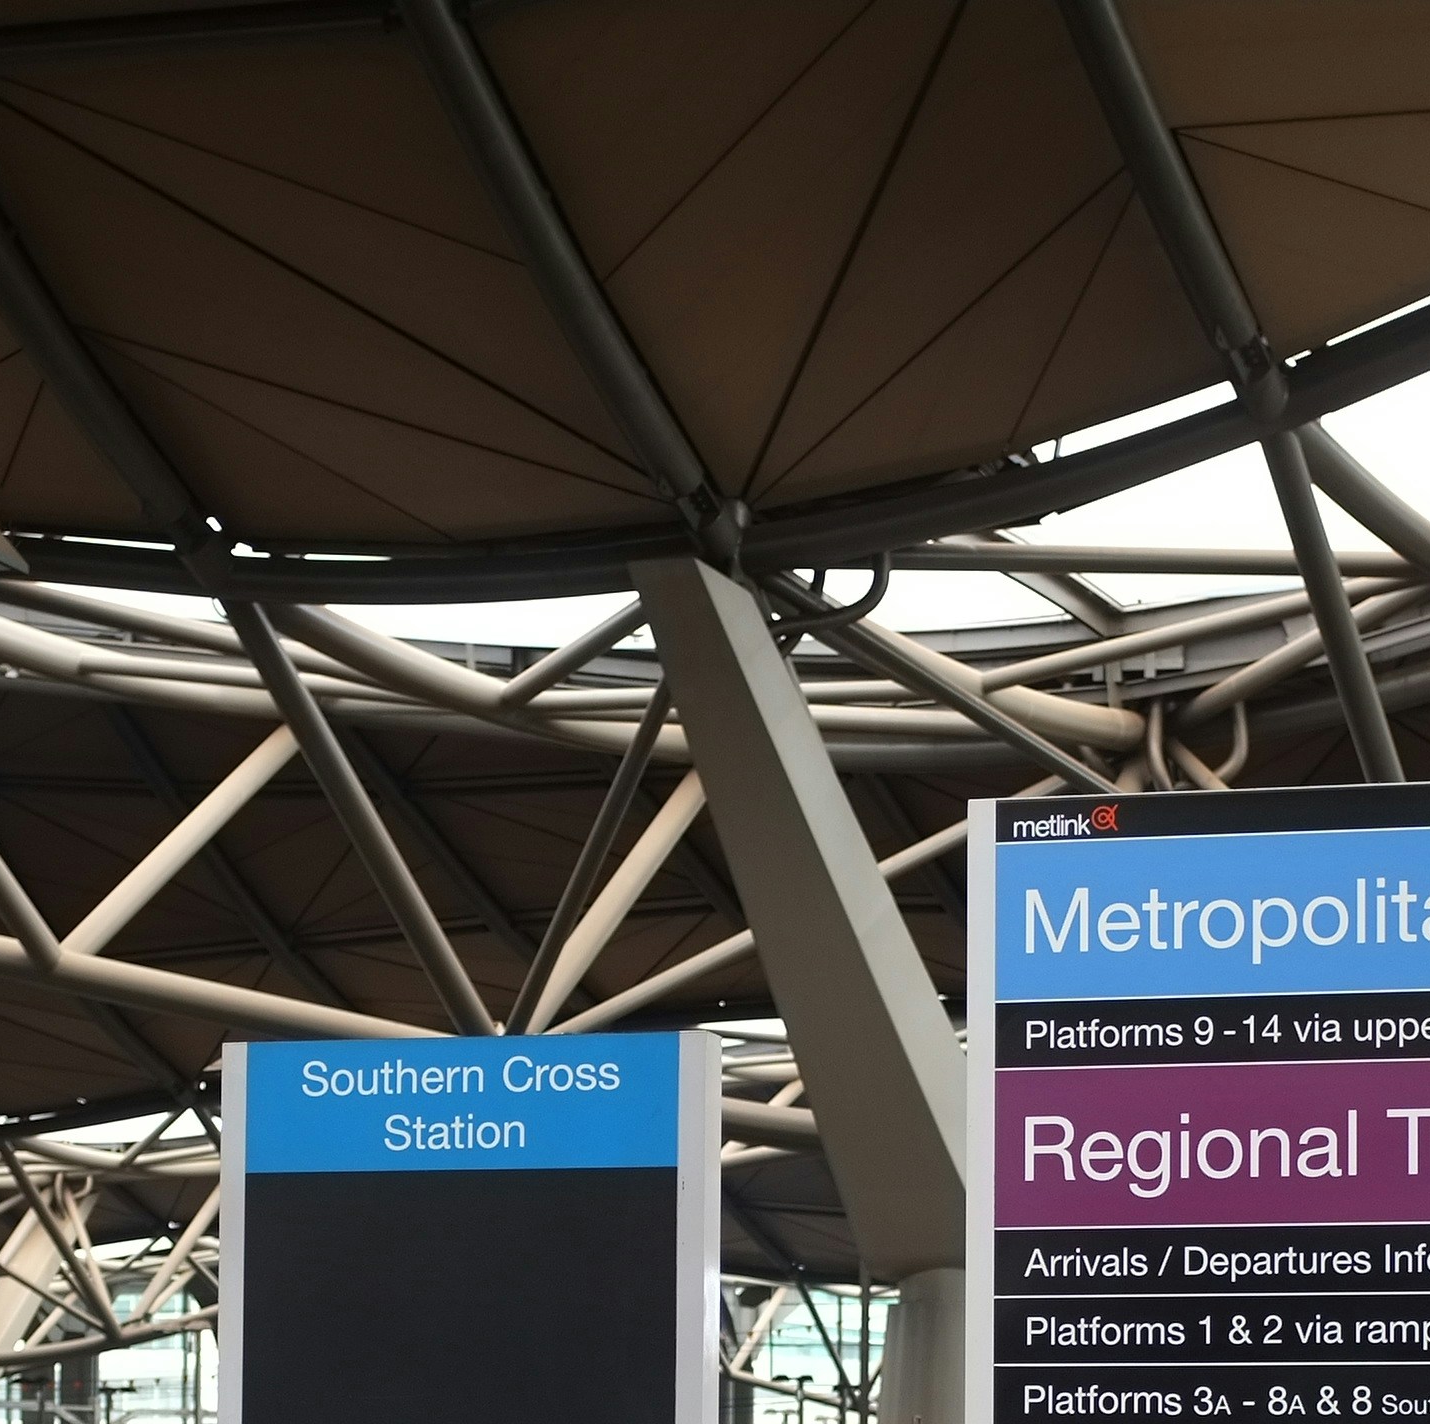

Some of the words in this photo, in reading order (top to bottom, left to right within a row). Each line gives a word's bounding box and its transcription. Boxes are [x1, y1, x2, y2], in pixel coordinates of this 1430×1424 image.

[1014, 813, 1090, 838] metlink
[1027, 1018, 1183, 1049] Platforms
[1194, 1016, 1213, 1045] 9
[1242, 1014, 1281, 1043] 14
[1294, 1012, 1341, 1043] via
[302, 1059, 483, 1097] Southern
[503, 1055, 620, 1092] Cross
[385, 1113, 524, 1151] Station
[1024, 1109, 1357, 1198] Regional
[1024, 1246, 1148, 1277] Arrivals
[1185, 1246, 1371, 1283] Departures
[1027, 1316, 1185, 1346] Platforms
[1199, 1315, 1210, 1344] 1
[1229, 1315, 1252, 1345] &
[1263, 1315, 1282, 1344] 2
[1295, 1314, 1343, 1344] via
[1025, 1384, 1182, 1415] Platforms
[1194, 1386, 1231, 1415] 3A
[1268, 1385, 1305, 1415] 8A
[1317, 1385, 1341, 1415] &
[1352, 1385, 1372, 1415] 8
